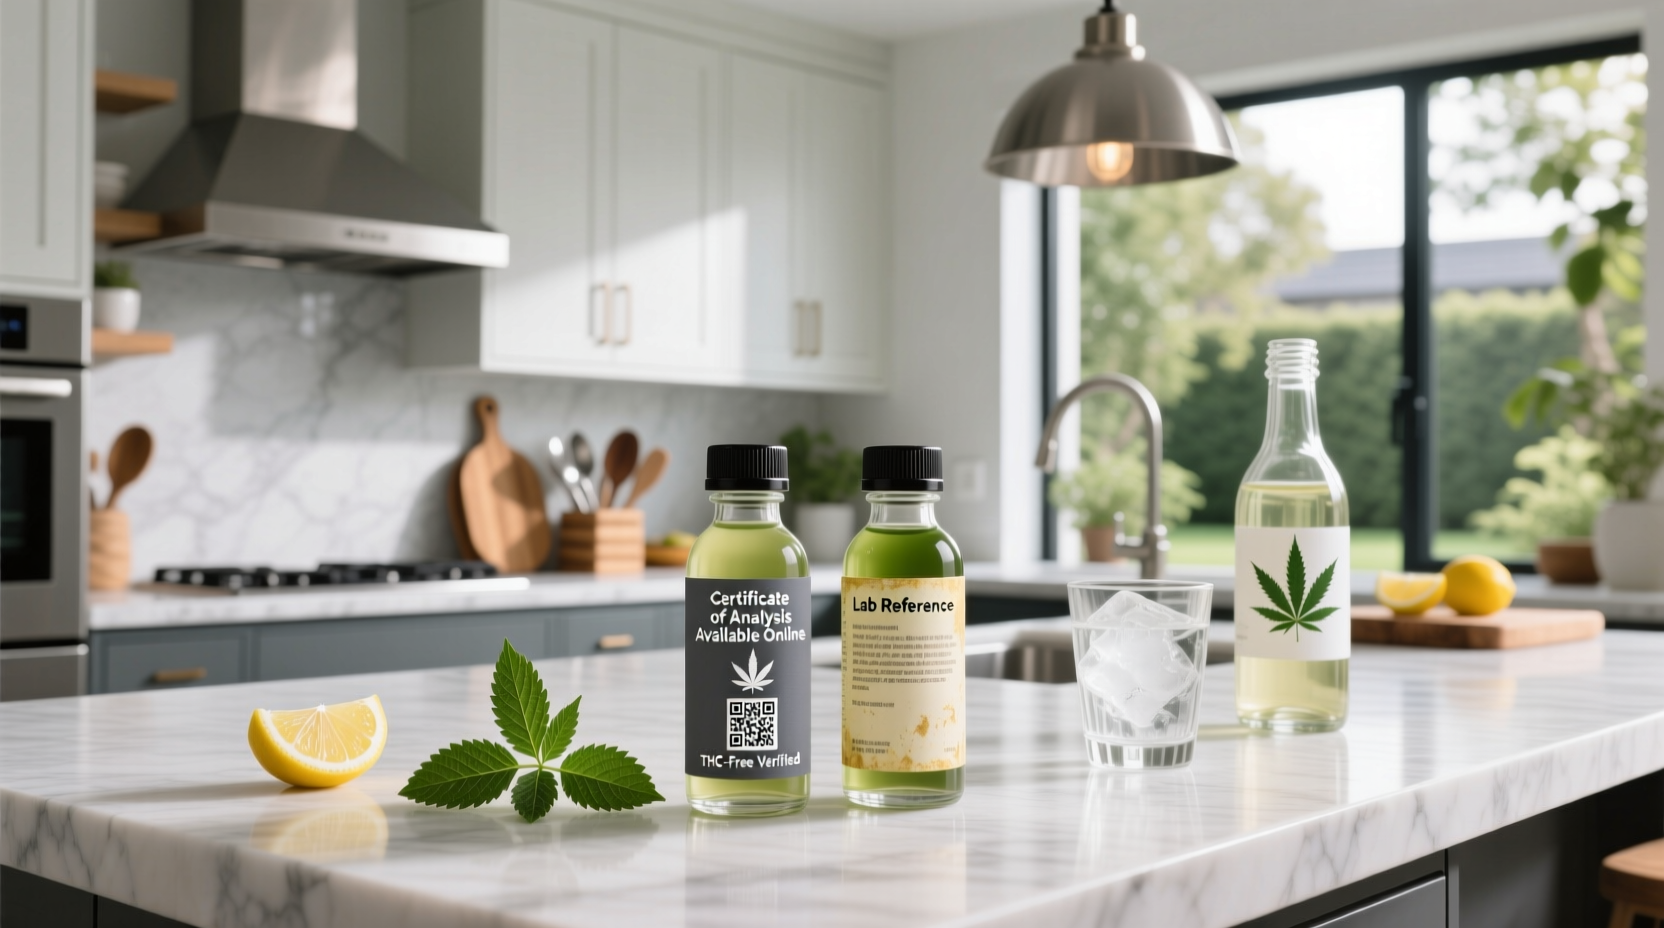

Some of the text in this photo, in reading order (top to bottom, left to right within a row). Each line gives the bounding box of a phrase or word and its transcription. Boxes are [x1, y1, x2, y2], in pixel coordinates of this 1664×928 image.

[710, 590, 790, 606] Certificate
[852, 596, 955, 613] Lab Reference
[710, 607, 792, 628] of Analysis
[695, 626, 806, 642] Available Online
[700, 754, 754, 769] THC-Free
